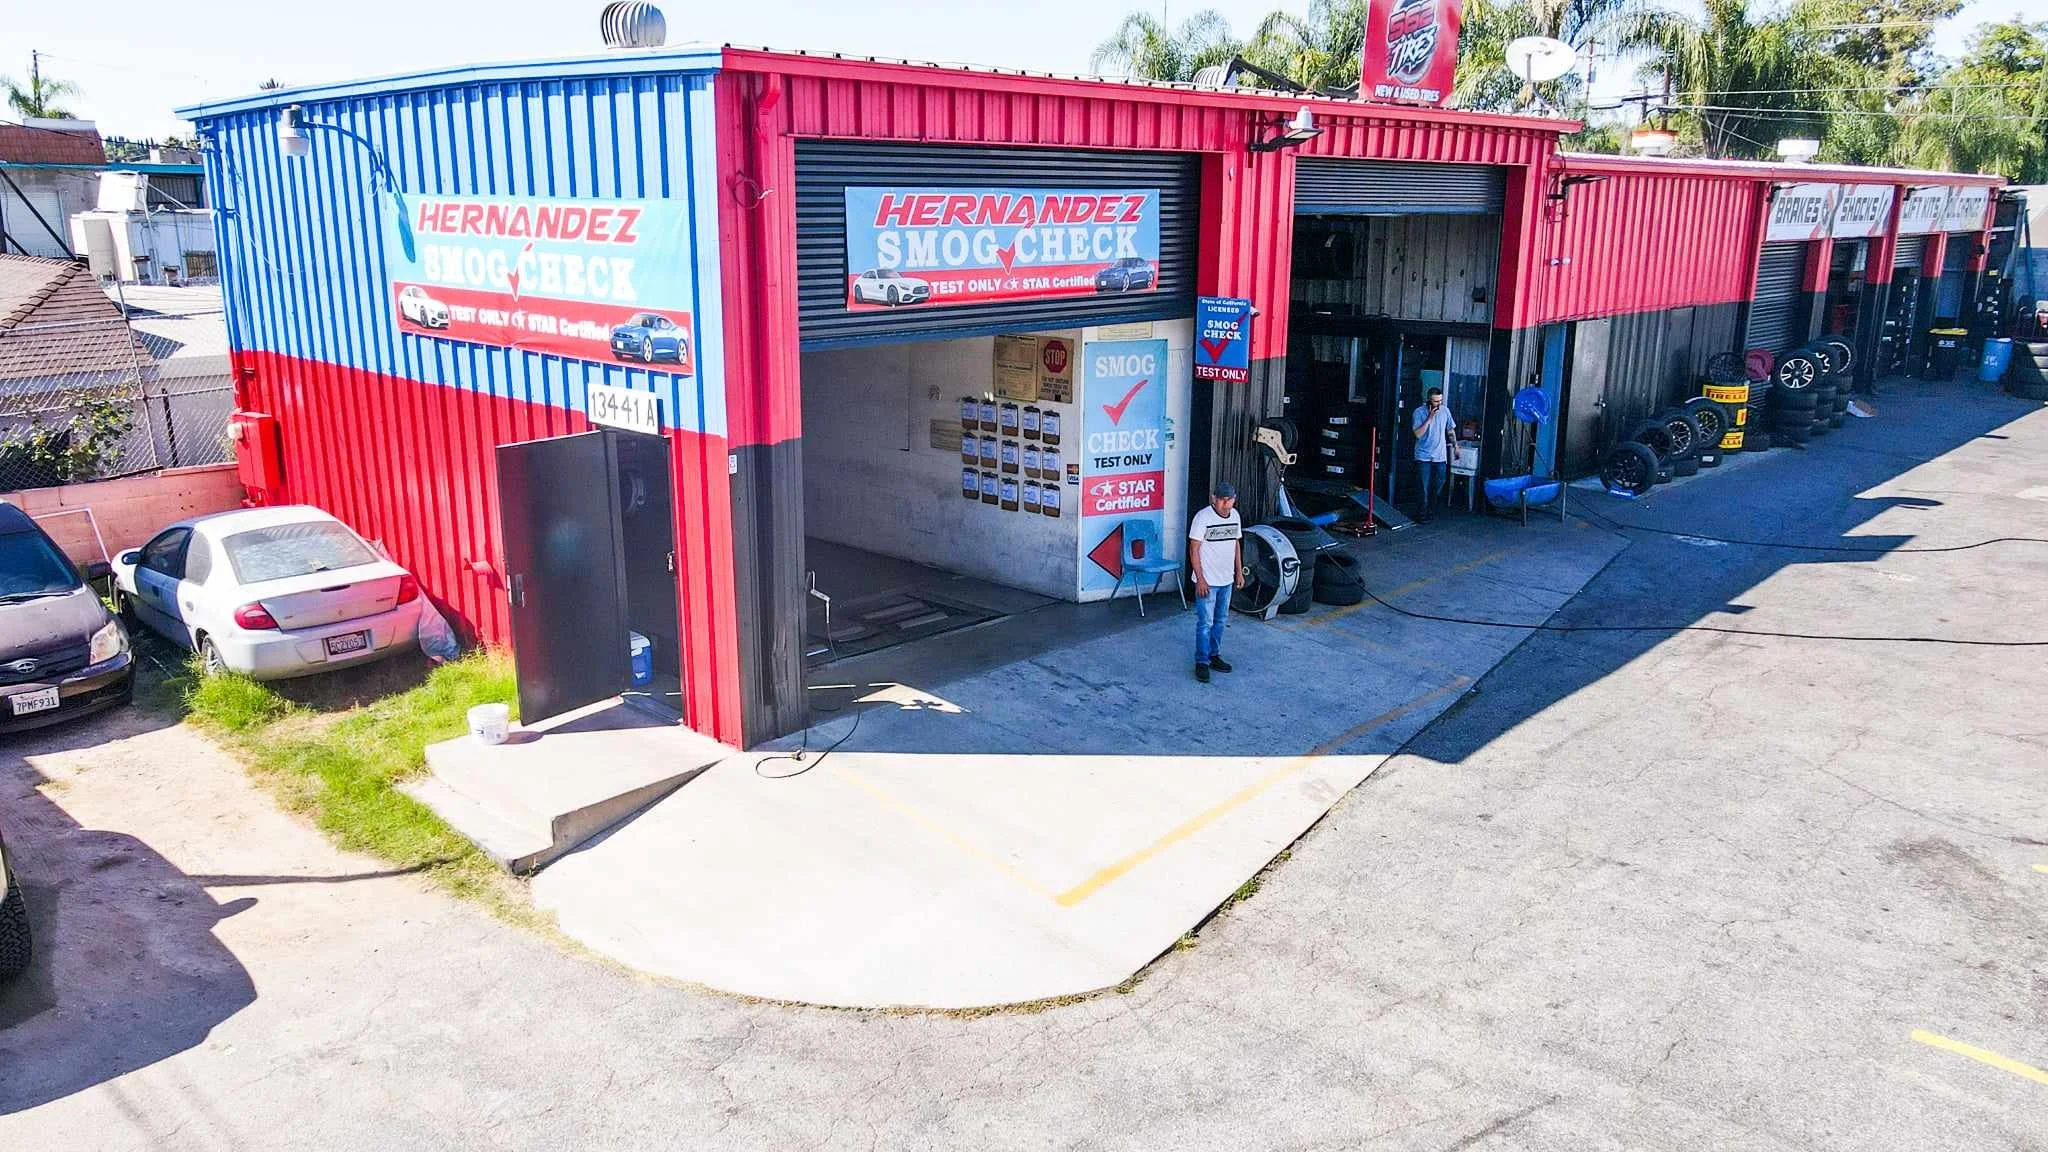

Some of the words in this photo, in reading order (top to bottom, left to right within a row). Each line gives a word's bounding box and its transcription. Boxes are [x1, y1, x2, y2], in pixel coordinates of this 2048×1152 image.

[1375, 85, 1394, 97] NEW
[1400, 87, 1420, 100] USED
[1420, 88, 1440, 101] TIRES
[874, 193, 1147, 227] HERNANDEZ
[1775, 197, 1822, 224] BRAKES
[1840, 197, 1879, 222] SHOCKS
[1922, 197, 1942, 218] KITS
[417, 202, 642, 244] HERNANDEZ
[877, 229, 1001, 269] SMOG
[1014, 226, 1138, 264] CHECK
[423, 246, 509, 287] SMOG
[518, 252, 637, 300] CHECK
[931, 280, 964, 295] TEST
[967, 278, 1001, 293] ONLY
[1023, 277, 1050, 289] STAR
[1052, 275, 1095, 288] Certified
[449, 305, 476, 322] TEST
[478, 308, 510, 327] ONLY
[527, 313, 558, 334] STAR
[559, 318, 610, 341] Certified
[1207, 320, 1239, 330] SMOG
[1203, 330, 1241, 340] CHECK
[1045, 350, 1066, 366] STOP
[1095, 354, 1155, 378] SMOG
[1196, 366, 1220, 378] TEST
[1222, 368, 1247, 380] ONLY
[591, 391, 639, 424] 13441
[646, 399, 655, 426] A
[1088, 428, 1159, 454] CHECK
[1094, 456, 1122, 468] TEST
[1123, 454, 1152, 466] ONLY
[1118, 480, 1156, 495] STAR
[1095, 495, 1149, 511] Certified
[16, 697, 56, 712] 7PMF931
